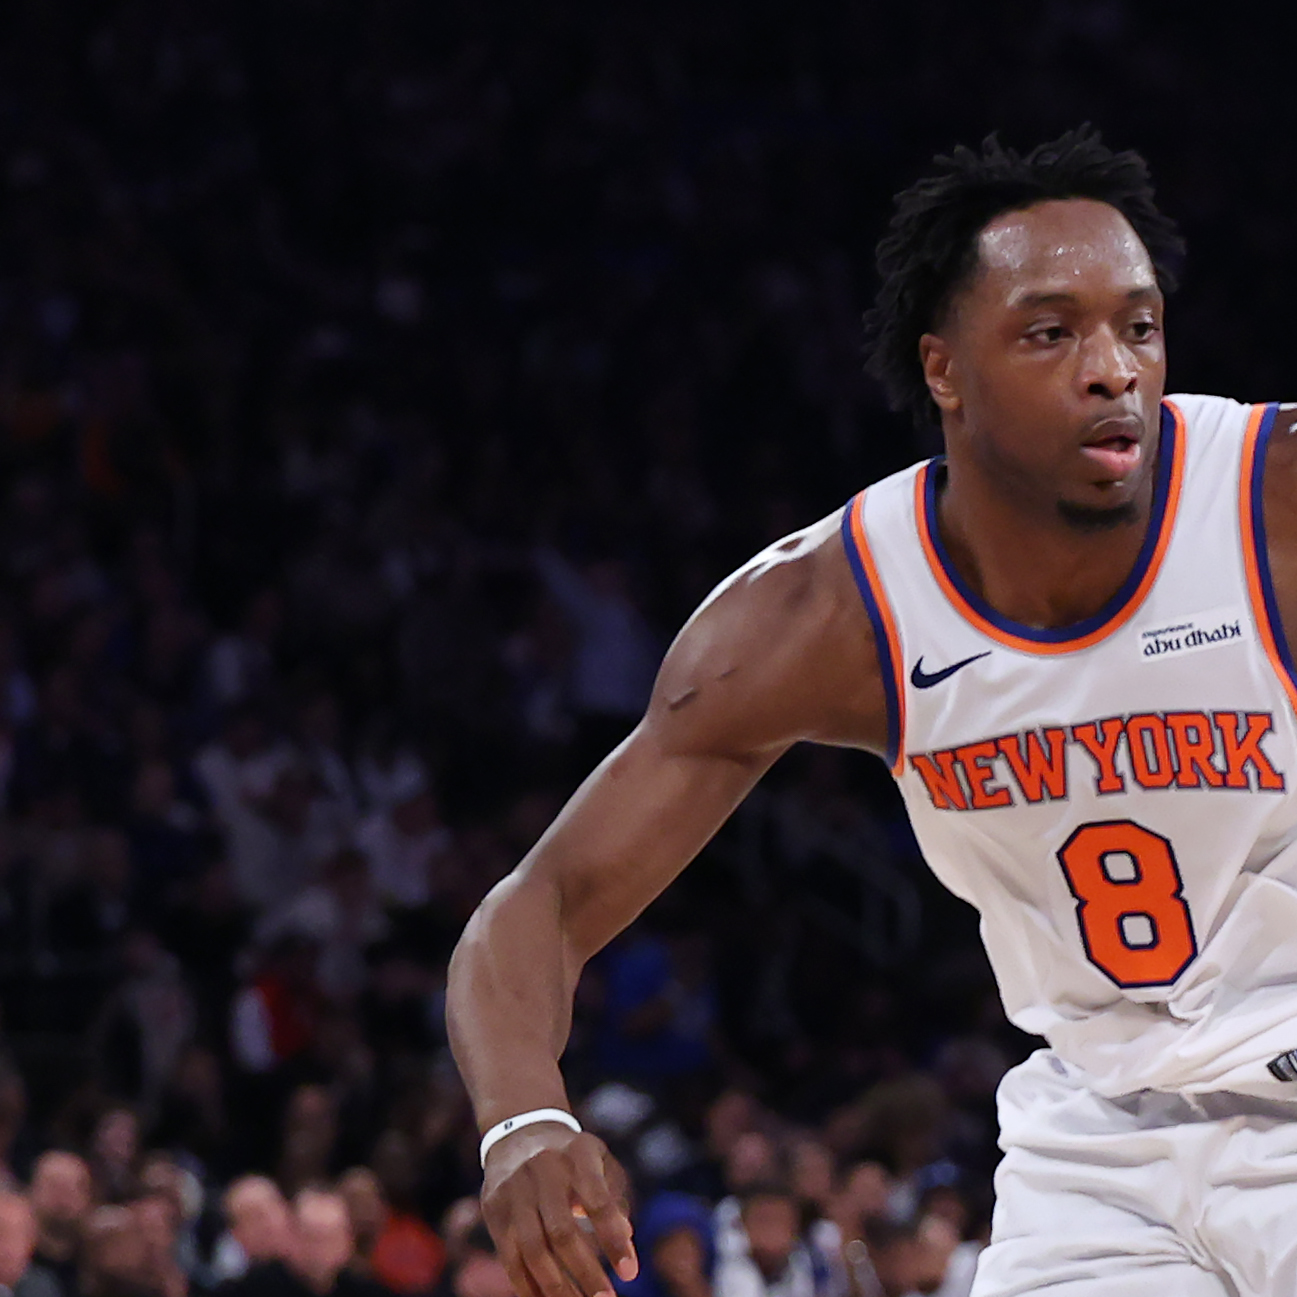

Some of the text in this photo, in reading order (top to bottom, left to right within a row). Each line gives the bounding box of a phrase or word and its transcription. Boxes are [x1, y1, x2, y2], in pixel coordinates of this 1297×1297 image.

[1143, 619, 1242, 656] abu dhabi
[907, 711, 1286, 811] NEW YORK
[1057, 819, 1198, 989] 8
